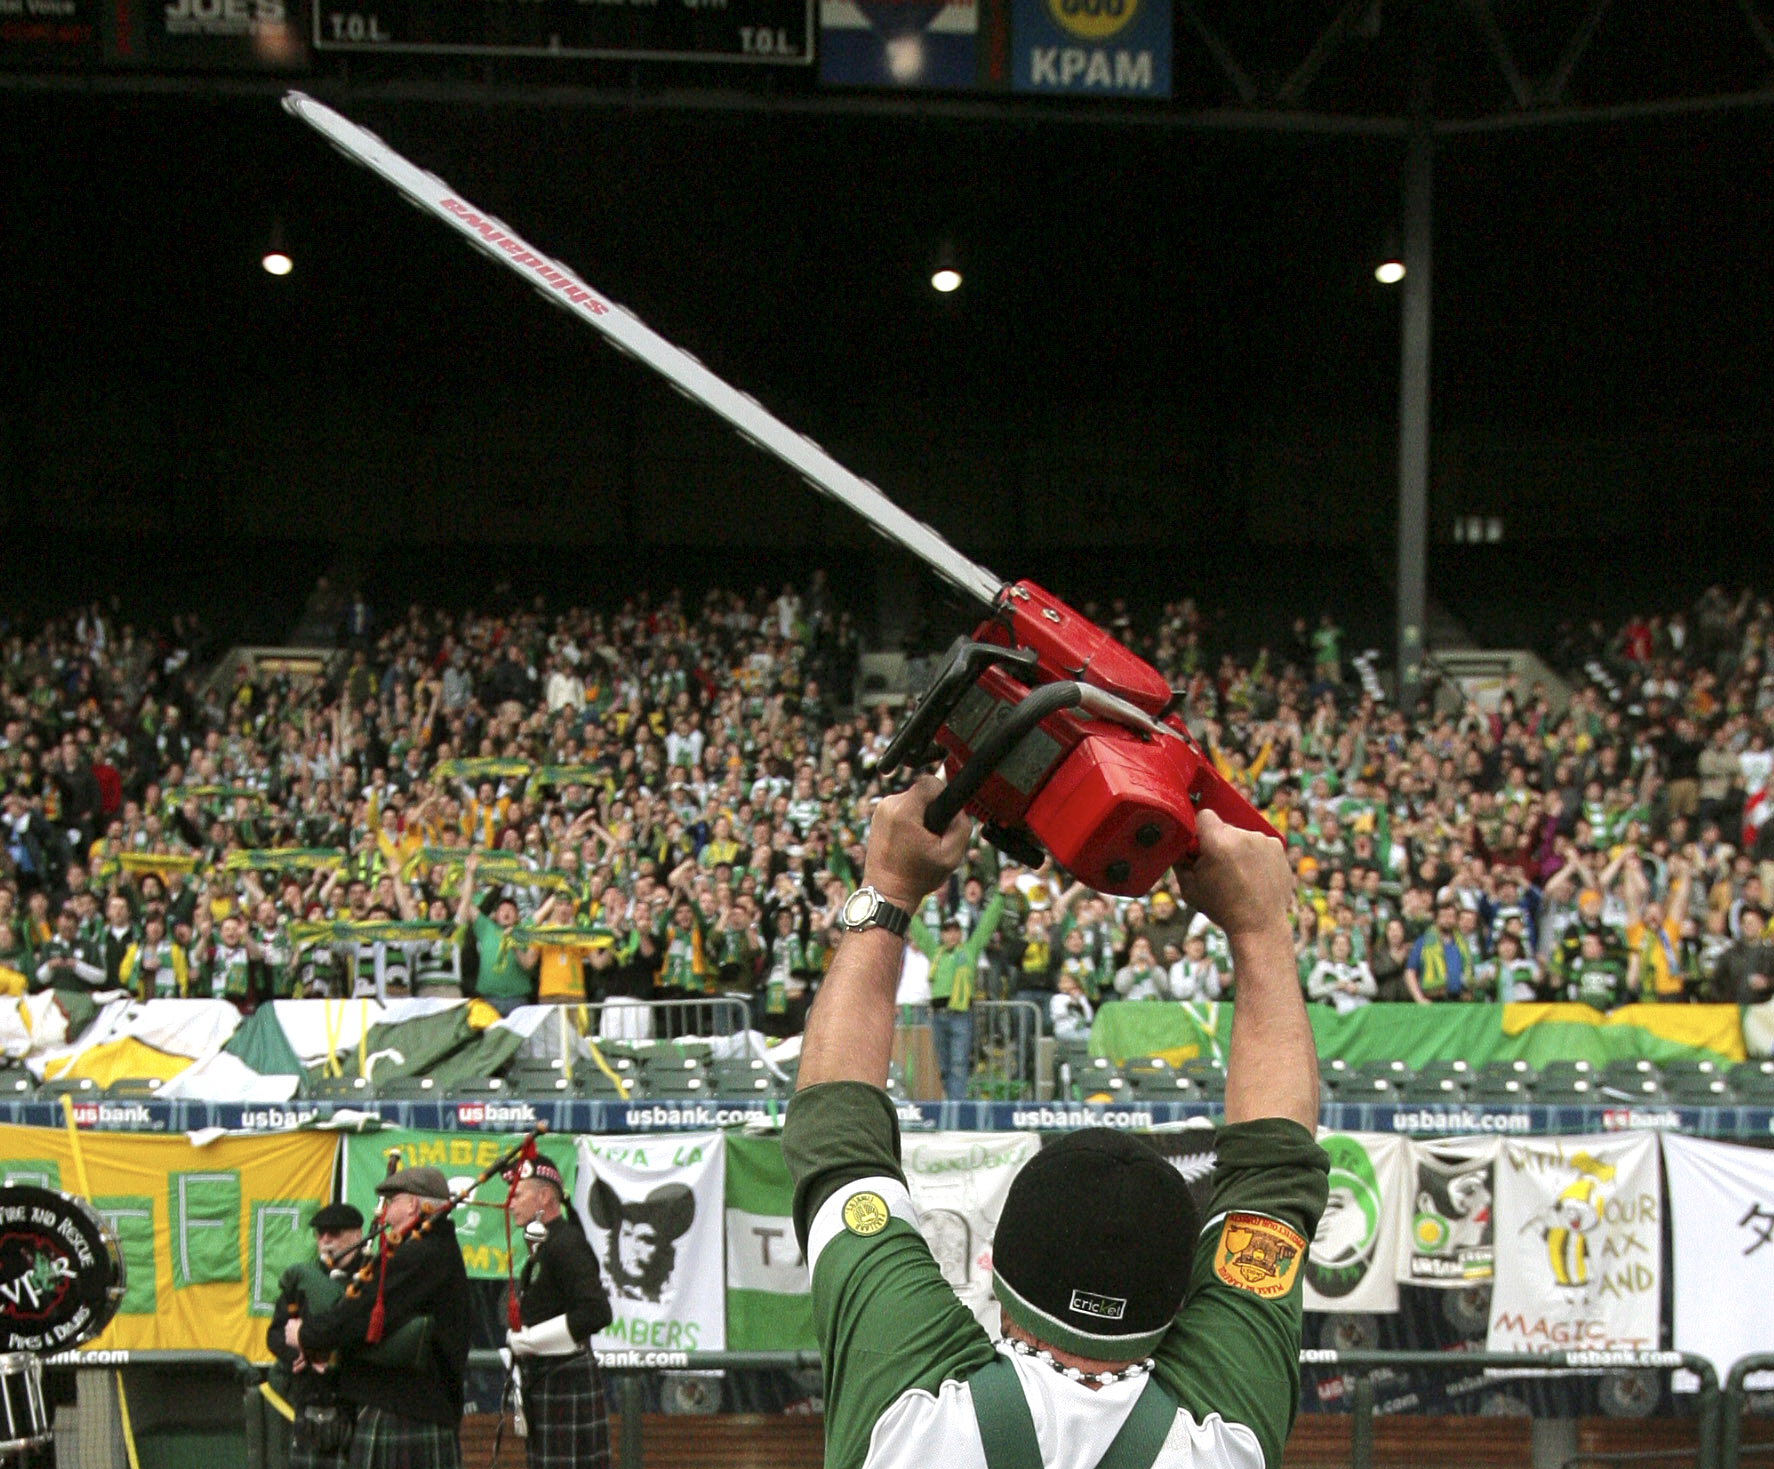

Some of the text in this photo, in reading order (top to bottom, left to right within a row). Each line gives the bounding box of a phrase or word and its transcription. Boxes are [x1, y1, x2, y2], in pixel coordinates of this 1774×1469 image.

[1030, 47, 1152, 90] KPAM
[440, 198, 609, 315] shindaiwa
[73, 1104, 151, 1123] usbank
[459, 1103, 536, 1121] usbank
[1012, 1108, 1151, 1127] usbank.com
[1393, 1112, 1530, 1132] usbank.com
[672, 1146, 704, 1167] LA
[1600, 1262, 1654, 1299] AND
[605, 1315, 700, 1351] MBERS
[1494, 1311, 1606, 1343] MAGIC
[594, 1351, 688, 1367] bank.com
[1566, 1350, 1683, 1367] usbank.com
